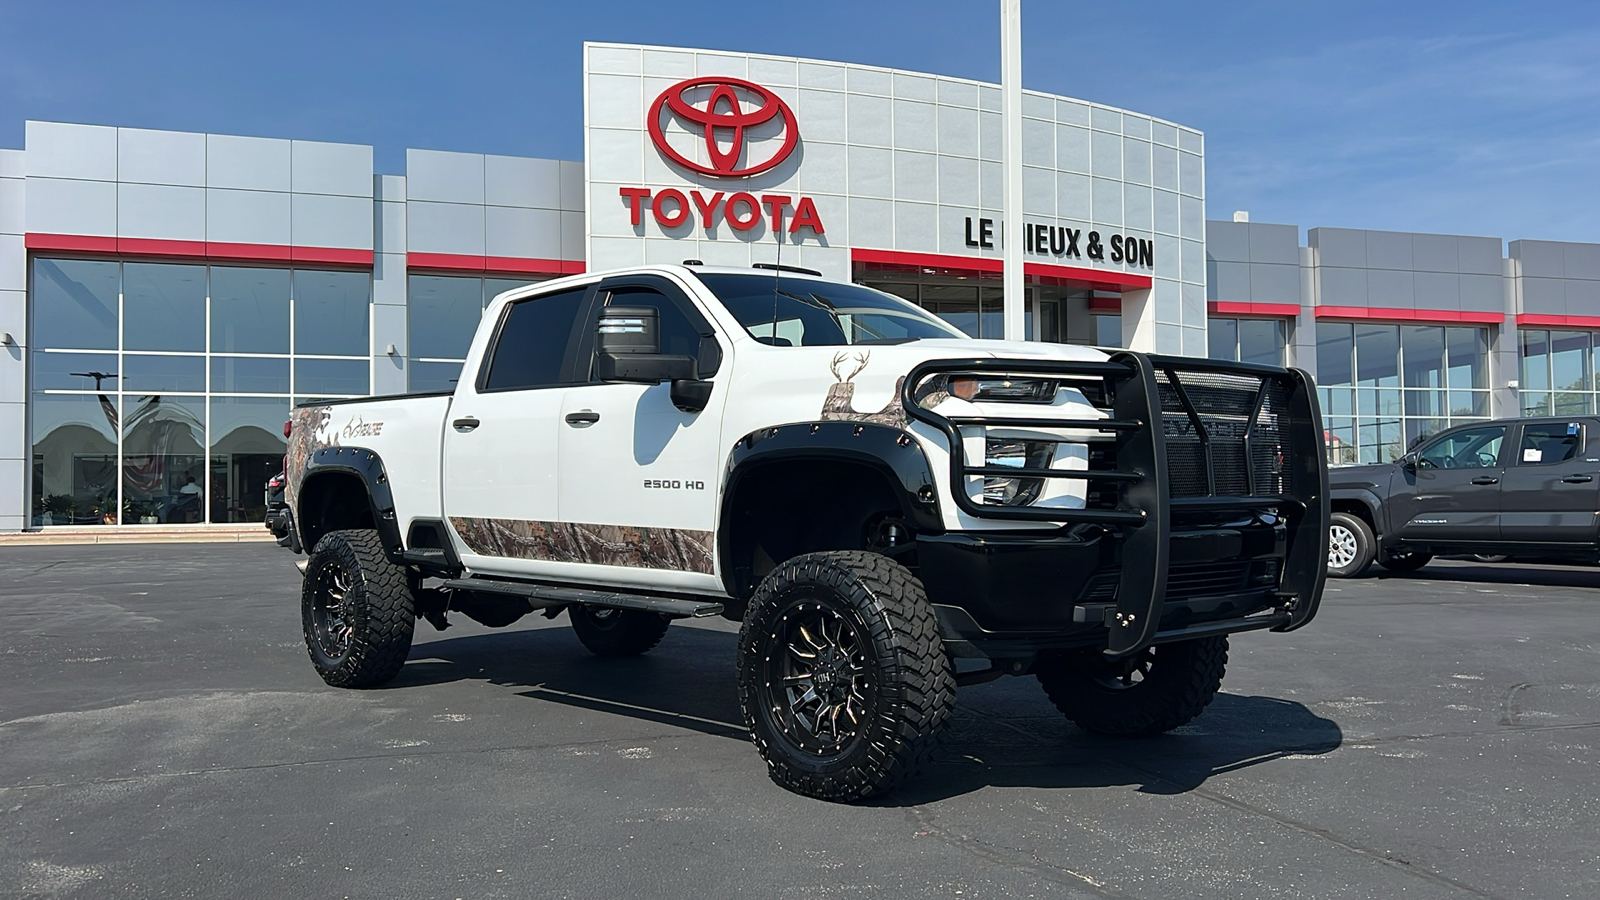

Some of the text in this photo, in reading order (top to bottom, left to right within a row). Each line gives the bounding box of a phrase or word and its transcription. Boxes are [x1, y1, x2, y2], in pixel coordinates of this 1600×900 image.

[619, 187, 825, 234] TOYOTA
[965, 216, 1154, 266] LE IEUX & SON
[643, 479, 705, 490] 2500 HD
